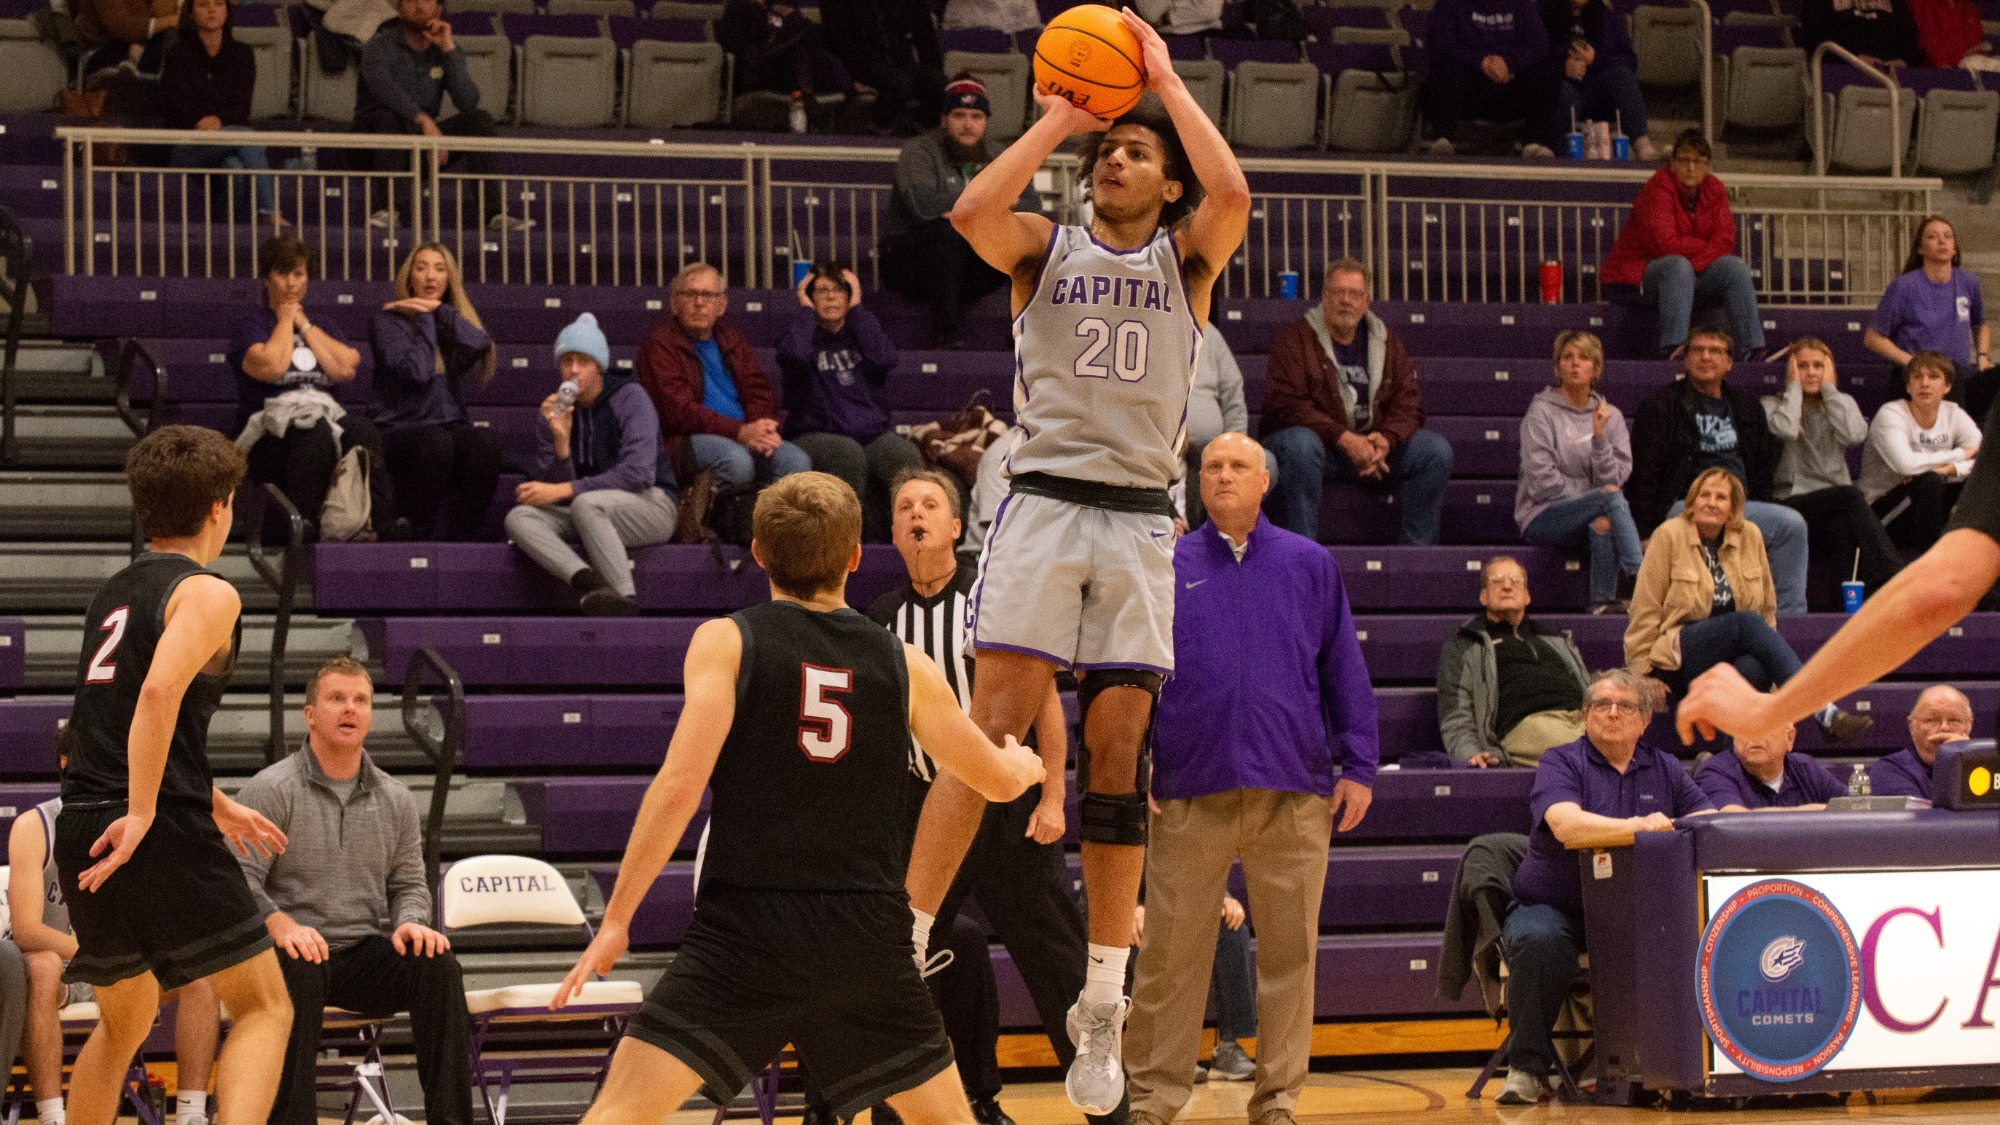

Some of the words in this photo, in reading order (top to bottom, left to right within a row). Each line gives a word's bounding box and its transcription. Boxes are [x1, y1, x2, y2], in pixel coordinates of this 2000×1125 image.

[1051, 275, 1172, 313] CAPITAL
[1074, 316, 1149, 382] 20
[85, 605, 130, 685] 2
[798, 662, 853, 763] 5
[460, 875, 556, 893] CAPITAL
[1747, 883, 1803, 898] PROPORTION
[1705, 900, 1737, 953] CITIZENSHIP
[1812, 895, 1858, 967] COMPREHENSIVE
[1701, 966, 1731, 1048] SPORTSMANSHIP
[1737, 987, 1824, 1017] CAPITAL
[1845, 970, 1859, 1023] LEARNING
[1752, 1013, 1814, 1026] COMETS
[1736, 1054, 1804, 1076] RESPONSIBILITY
[1813, 1032, 1844, 1064] PASSION
